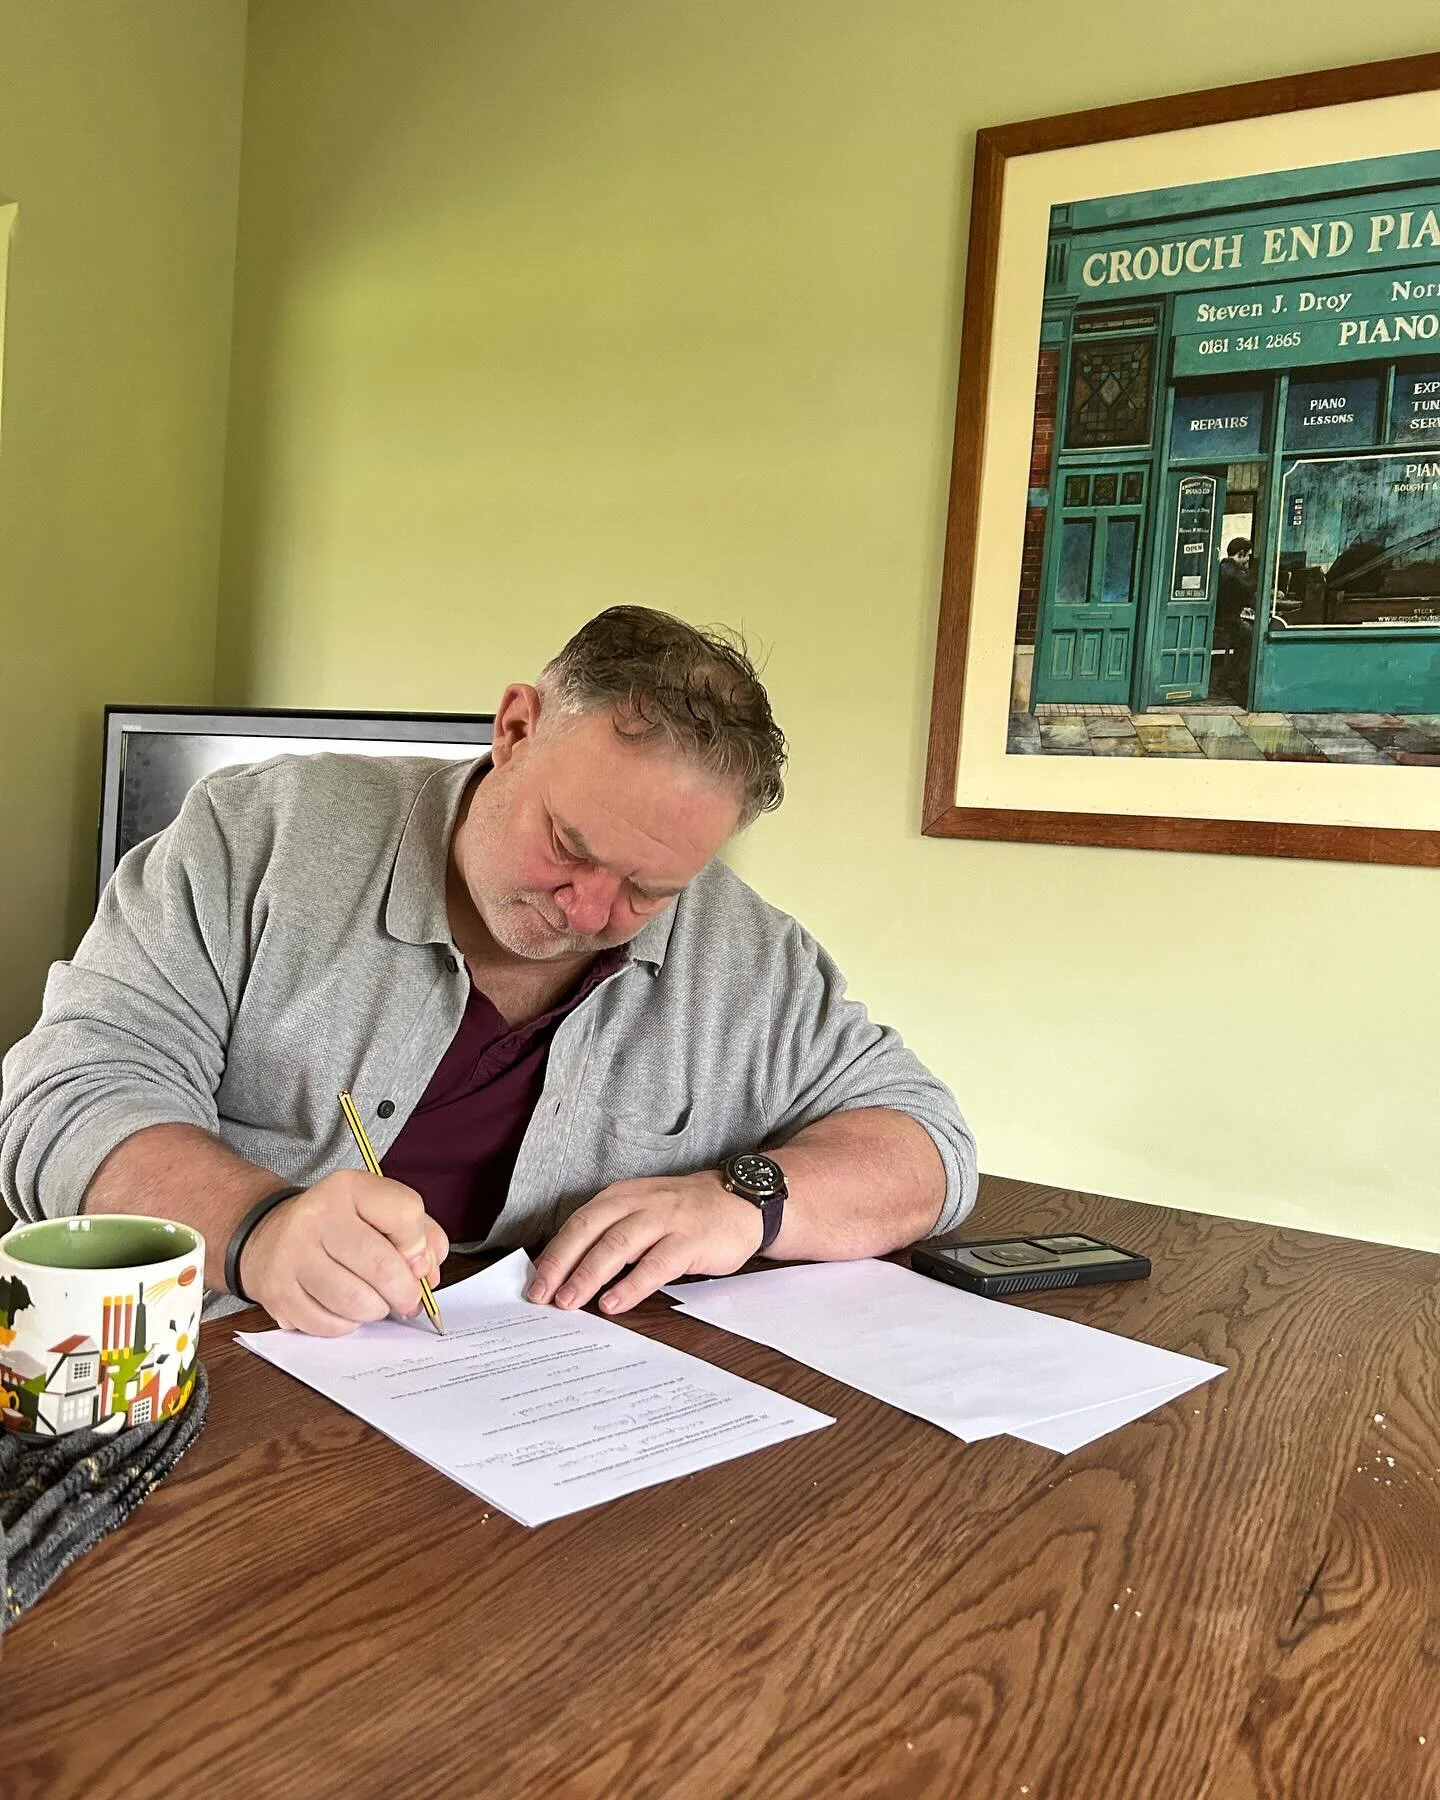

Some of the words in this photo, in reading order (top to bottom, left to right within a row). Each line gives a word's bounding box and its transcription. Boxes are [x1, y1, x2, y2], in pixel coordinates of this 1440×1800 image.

[1082, 234, 1244, 287] CROUCH
[1261, 220, 1354, 265] END
[1367, 209, 1440, 253] PIA
[1391, 281, 1440, 301] Nor
[1196, 303, 1263, 323] Steven
[1271, 294, 1288, 314] J.
[1298, 291, 1353, 313] Droy
[1337, 314, 1440, 346] PIANO
[1198, 338, 1230, 355] 0181
[1235, 335, 1259, 351] 341
[1266, 331, 1302, 349] 2865
[1413, 381, 1440, 395] EXP
[1309, 397, 1346, 411] PIANO
[1189, 416, 1249, 432] REPAIRS
[1303, 413, 1354, 426] LESSONS
[1185, 545, 1202, 553] OPEN
